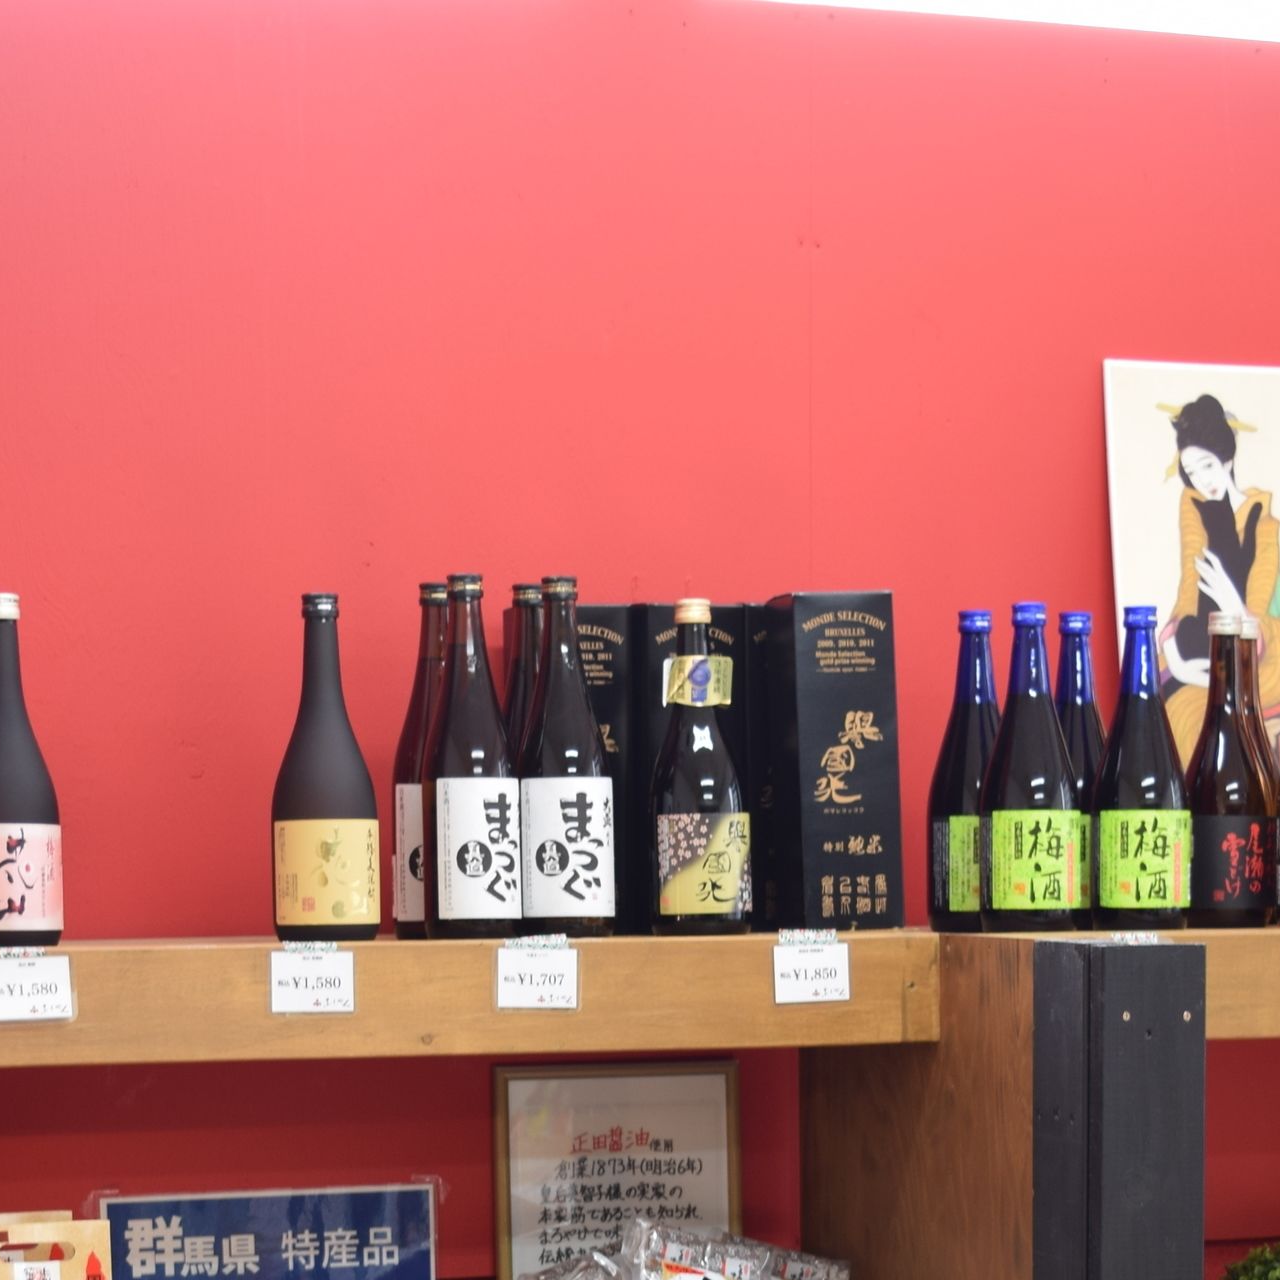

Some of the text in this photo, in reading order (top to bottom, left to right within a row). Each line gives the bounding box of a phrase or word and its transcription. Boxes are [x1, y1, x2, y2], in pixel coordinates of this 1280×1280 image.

[803, 610, 887, 632] MONDE SELECTION
[824, 628, 865, 637] BRUXELLES
[1028, 817, 1064, 903] 梅酒
[1134, 817, 1170, 903] 梅酒
[517, 972, 566, 988] ¥1,707
[792, 966, 838, 982] ¥1,850
[6, 982, 58, 998] ¥1,580
[292, 975, 342, 990] ¥1,580
[124, 1215, 400, 1279] 群馬県 特産品
